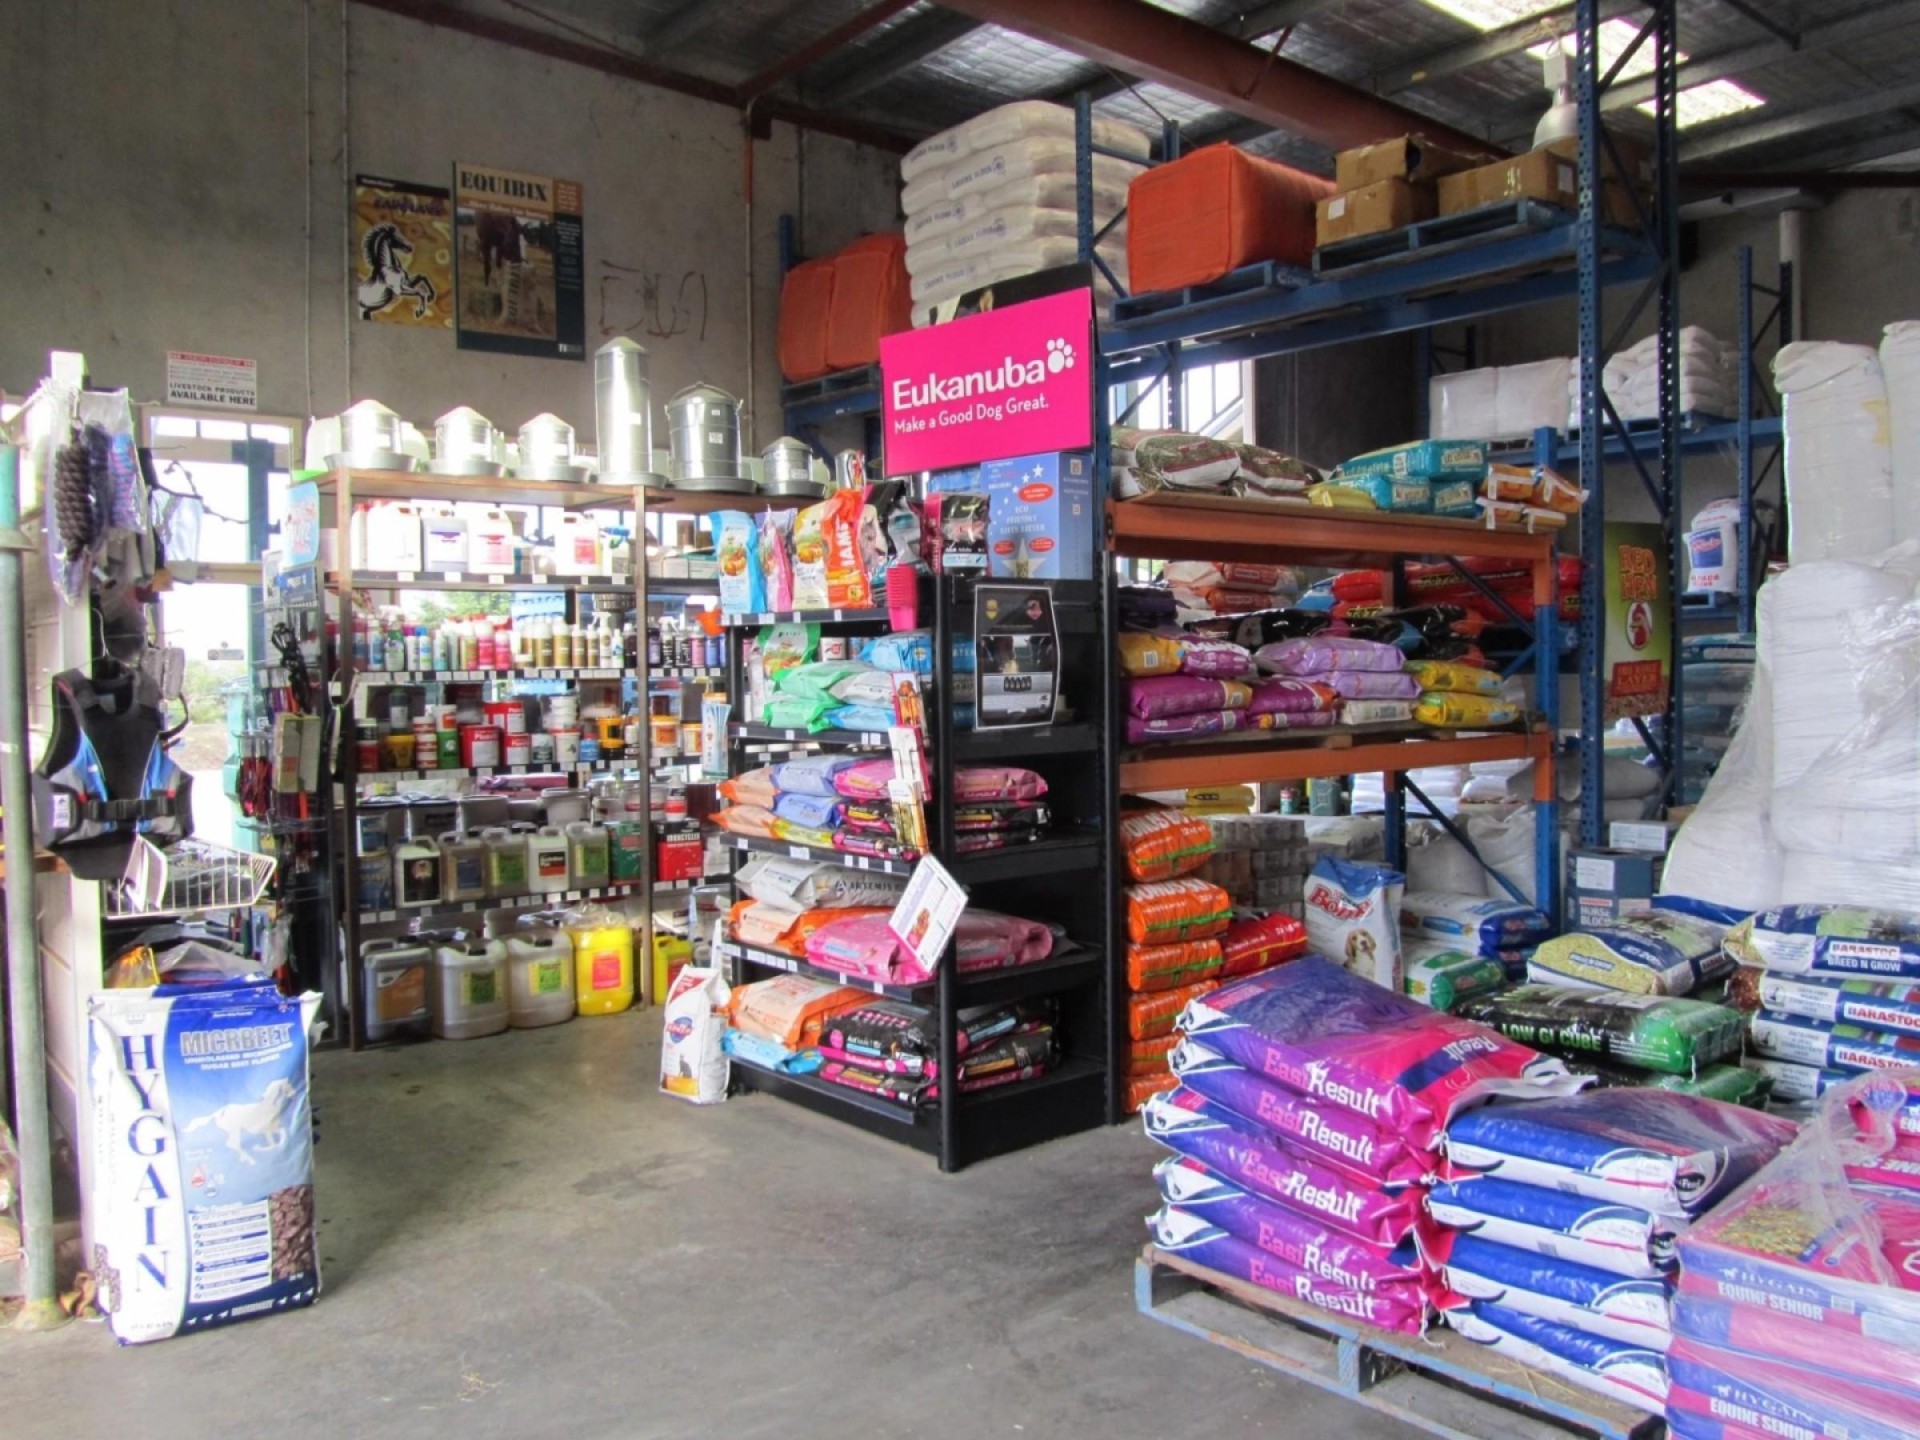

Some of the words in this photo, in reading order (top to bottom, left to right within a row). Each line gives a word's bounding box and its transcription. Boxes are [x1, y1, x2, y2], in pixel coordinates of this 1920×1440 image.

[460, 171, 547, 203] EQUIBIX
[169, 382, 213, 392] LIVESTOCK
[214, 386, 256, 396] PRODUCTS
[170, 390, 225, 403] AVAILABLE
[228, 395, 256, 406] HERE
[892, 356, 1046, 411] Eukanuba
[894, 416, 926, 434] Make
[928, 418, 937, 429] a
[938, 404, 973, 426] Good
[976, 403, 1004, 421] Dog
[1005, 393, 1049, 414] Great.
[834, 517, 856, 567] IAMS
[1618, 544, 1656, 574] RED
[1620, 573, 1657, 600] HEN
[1859, 959, 1869, 969] N
[1870, 959, 1902, 972] GROW
[1502, 1023, 1535, 1041] LOW
[1539, 1027, 1556, 1043] GI
[1559, 1028, 1602, 1050] CUBE
[1717, 1281, 1766, 1308] EQUINE
[1769, 1293, 1824, 1322] SENIOR
[1709, 1397, 1760, 1428] EQUINE
